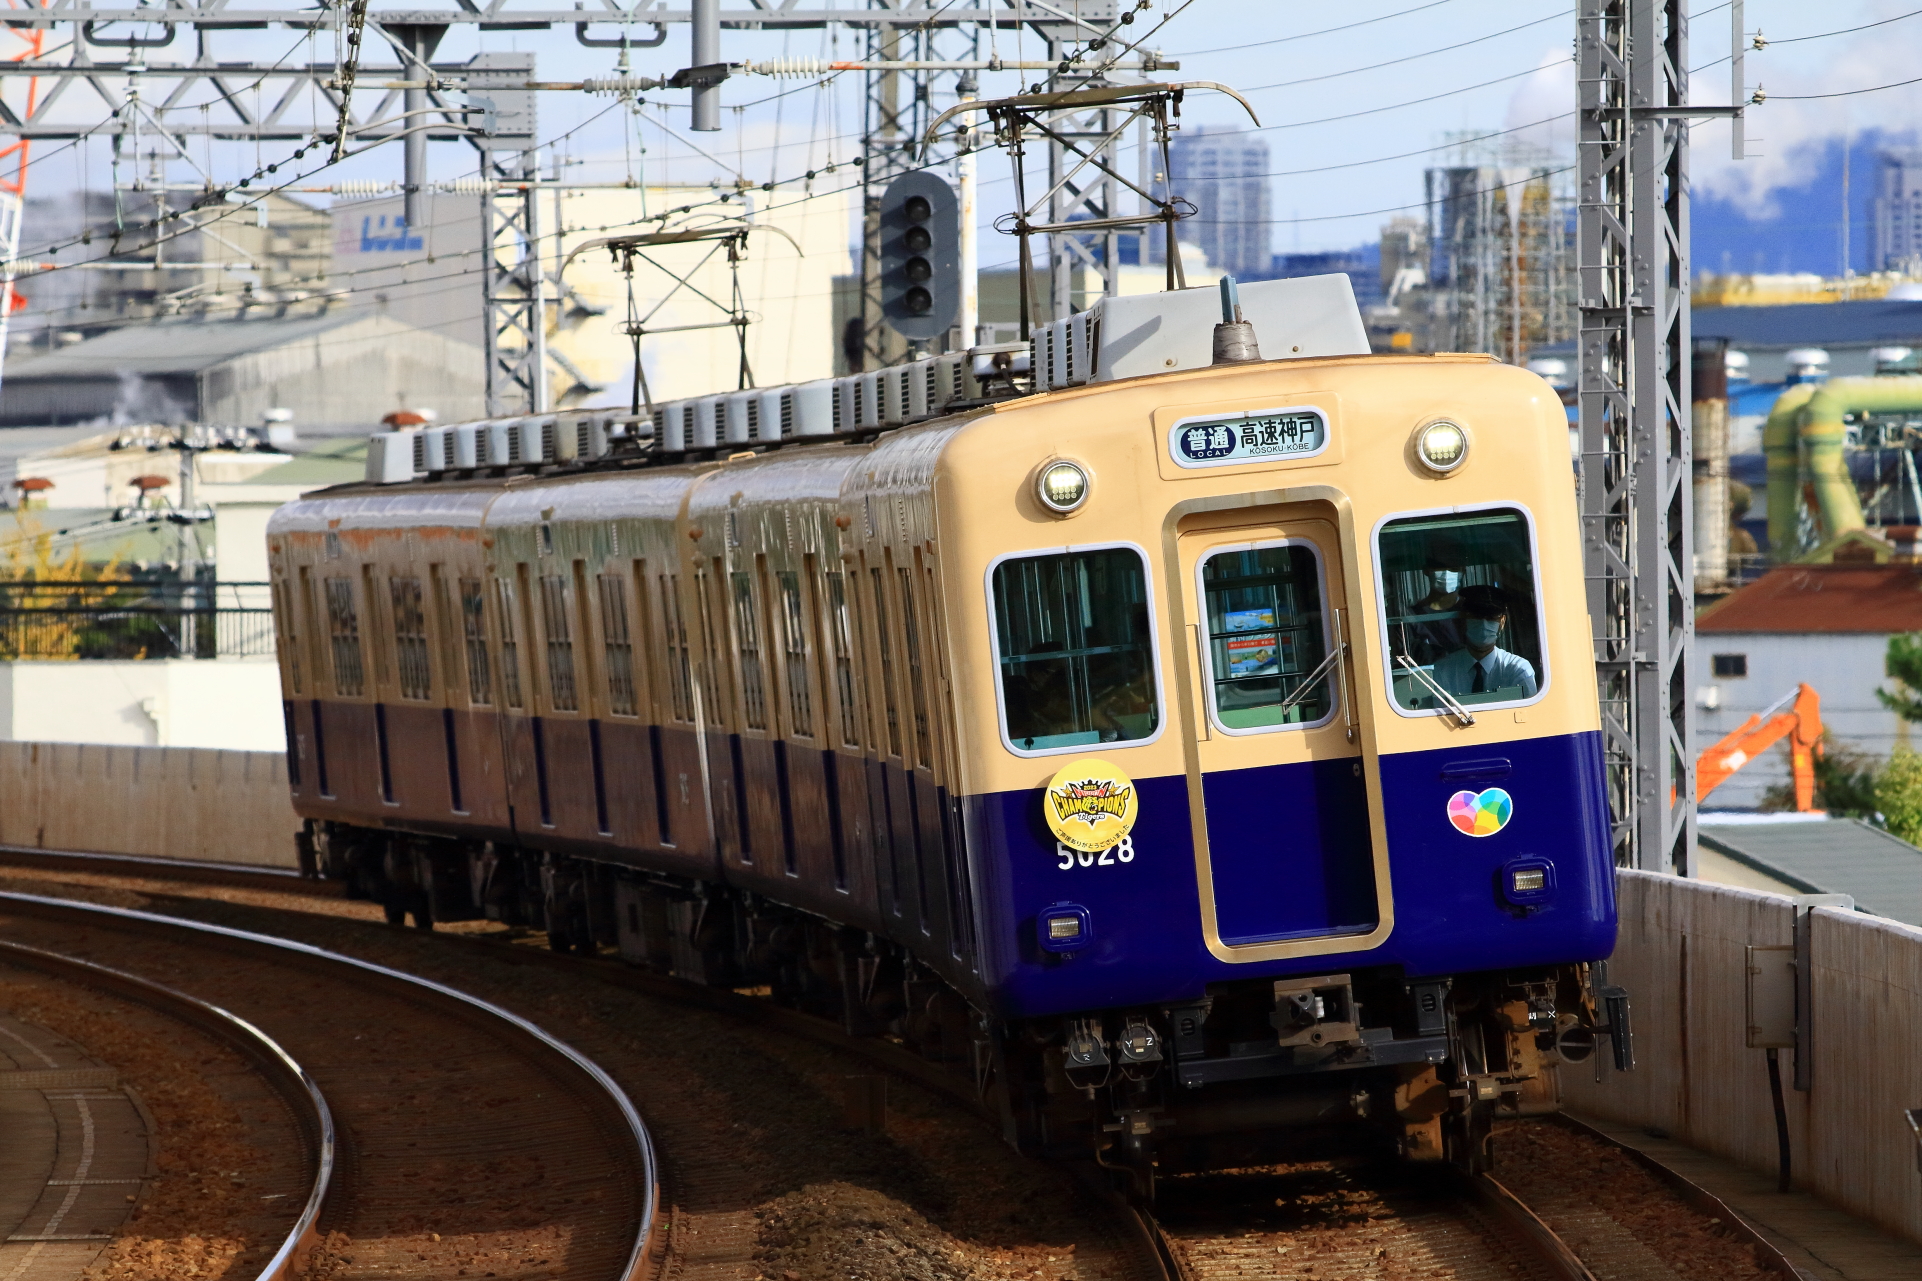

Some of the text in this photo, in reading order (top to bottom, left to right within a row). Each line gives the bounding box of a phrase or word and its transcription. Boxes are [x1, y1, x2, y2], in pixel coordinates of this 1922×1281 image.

[1188, 427, 1229, 450] 普通
[1239, 416, 1315, 447] 高速神戸
[1190, 450, 1230, 459] LOCAL
[1051, 787, 1130, 821] CHAMPIONS
[1078, 812, 1105, 822] Tigers
